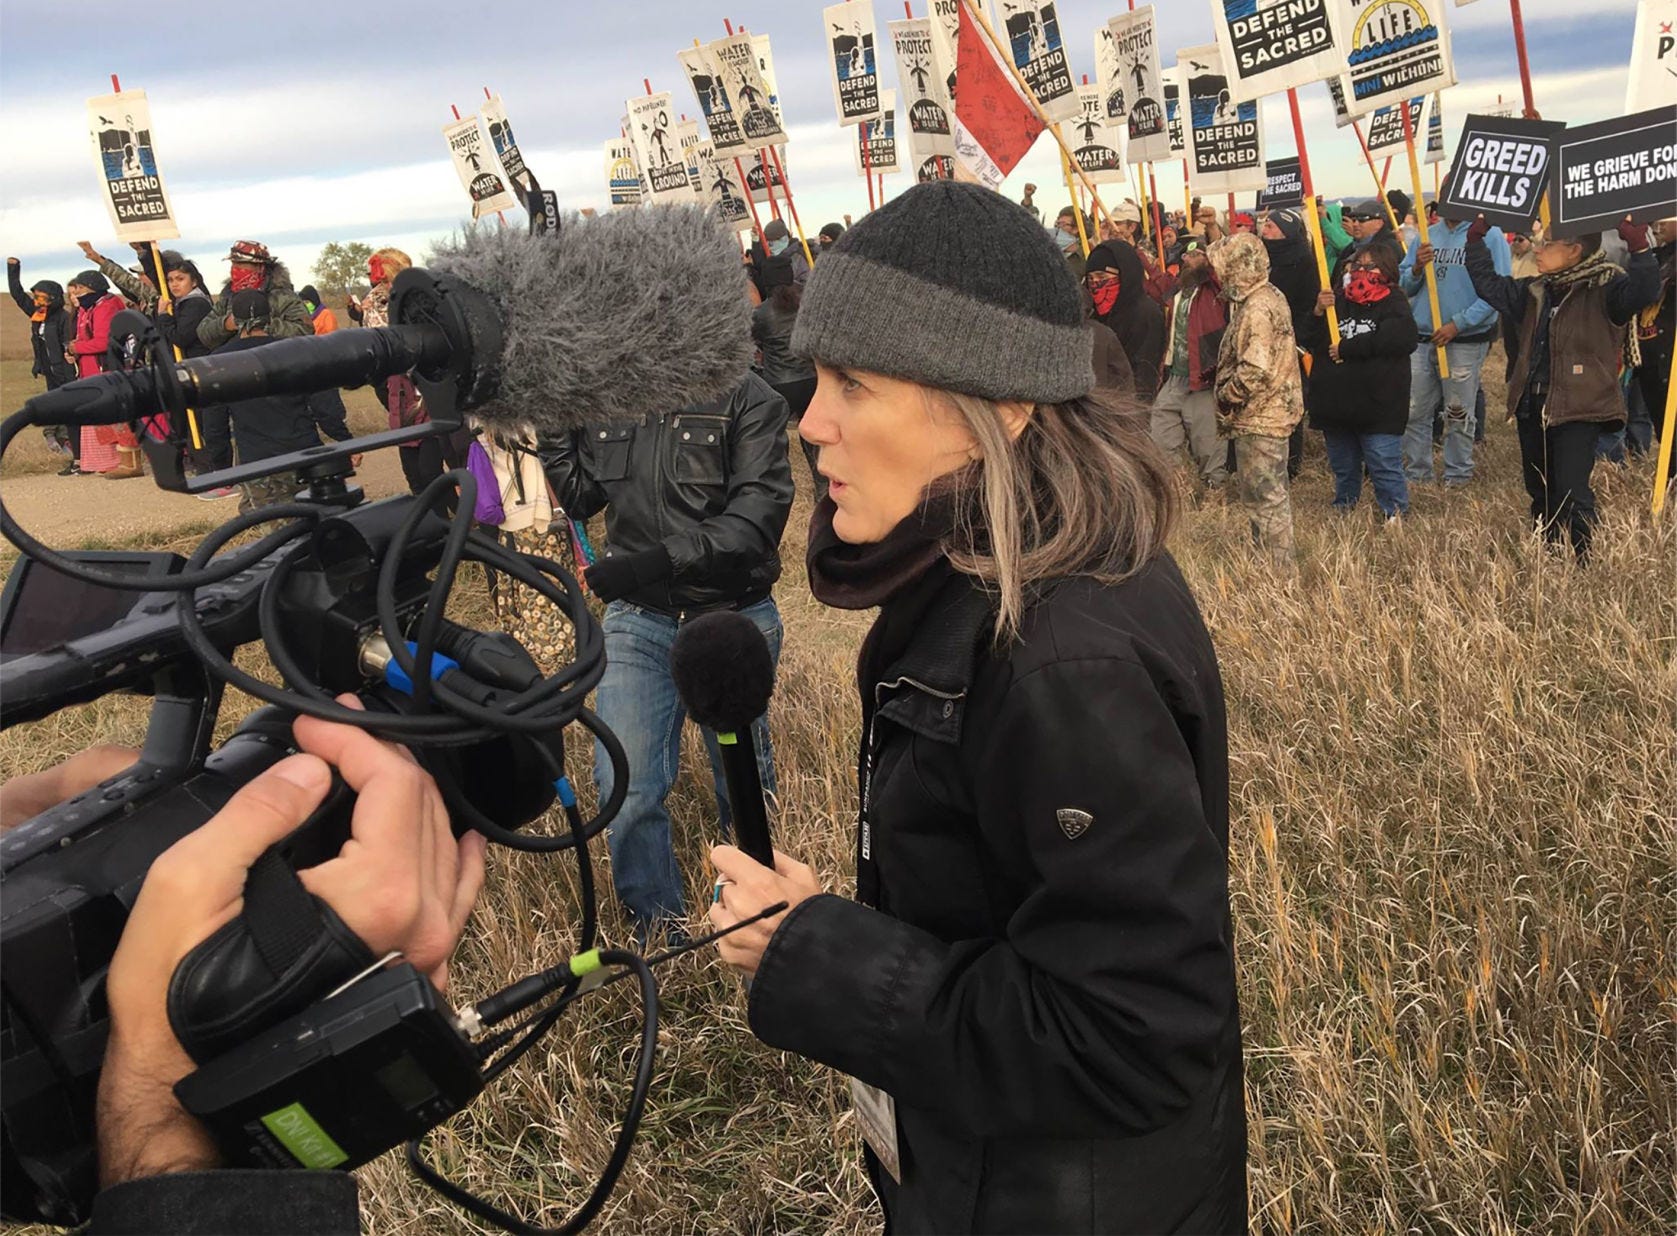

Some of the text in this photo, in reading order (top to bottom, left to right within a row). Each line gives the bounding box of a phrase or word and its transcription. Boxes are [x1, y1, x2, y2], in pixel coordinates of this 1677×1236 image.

[1232, 0, 1320, 39] DEFEND
[1366, 8, 1412, 43] LIFE
[1267, 23, 1294, 41] THE
[716, 42, 752, 61] WATER
[895, 38, 932, 55] PROTECT
[1117, 28, 1153, 56] PROTECT
[1240, 26, 1327, 70] SACRED
[1019, 51, 1063, 80] DEFEND
[839, 74, 876, 92] DEFEND
[1037, 71, 1051, 83] THE
[854, 90, 865, 98] THE
[1032, 76, 1069, 99] ACRED
[843, 97, 878, 113] SACRED
[912, 105, 944, 121] WATER
[1131, 103, 1161, 122] WATER
[450, 130, 481, 152] PROTECT
[1195, 122, 1255, 143] DEFEND
[1216, 140, 1235, 150] THE
[1197, 149, 1257, 168] SACRED
[1465, 137, 1548, 176] GREED
[1567, 163, 1591, 182] WE
[1593, 149, 1650, 177] GRIEVE
[922, 158, 955, 176] WAER
[110, 176, 158, 195] DEFEND
[471, 174, 499, 193] WATER
[653, 171, 686, 191] GROUND
[1275, 181, 1302, 195] SACRED
[1459, 170, 1531, 208] KILLS
[1565, 161, 1677, 200] THE HARM DON
[117, 200, 165, 218] SACRED
